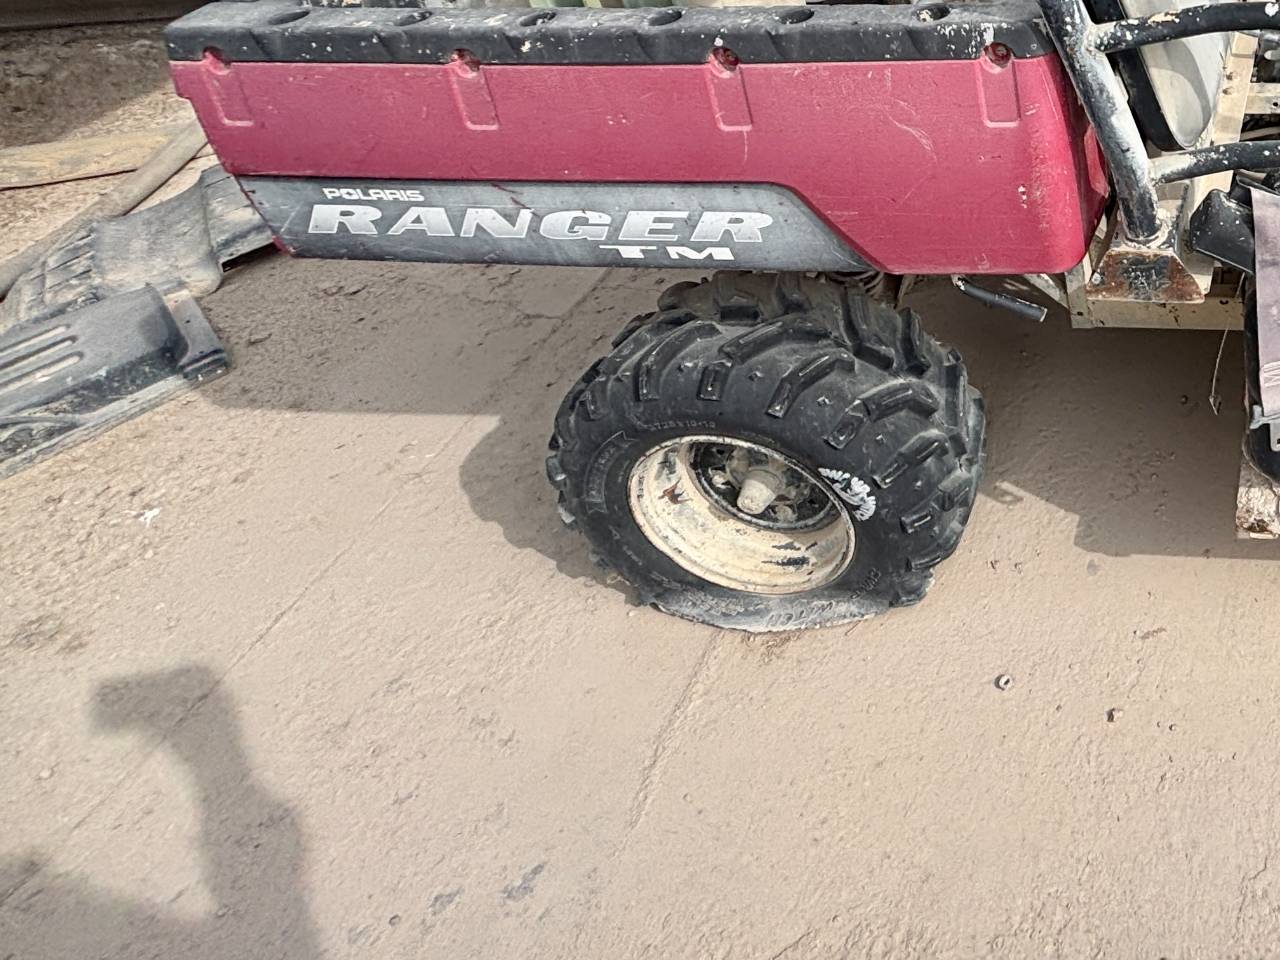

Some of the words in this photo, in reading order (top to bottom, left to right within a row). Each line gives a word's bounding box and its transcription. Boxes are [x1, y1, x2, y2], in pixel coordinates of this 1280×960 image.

[322, 188, 425, 202] POLARIS
[308, 204, 774, 243] RANGER
[599, 244, 735, 262] TM
